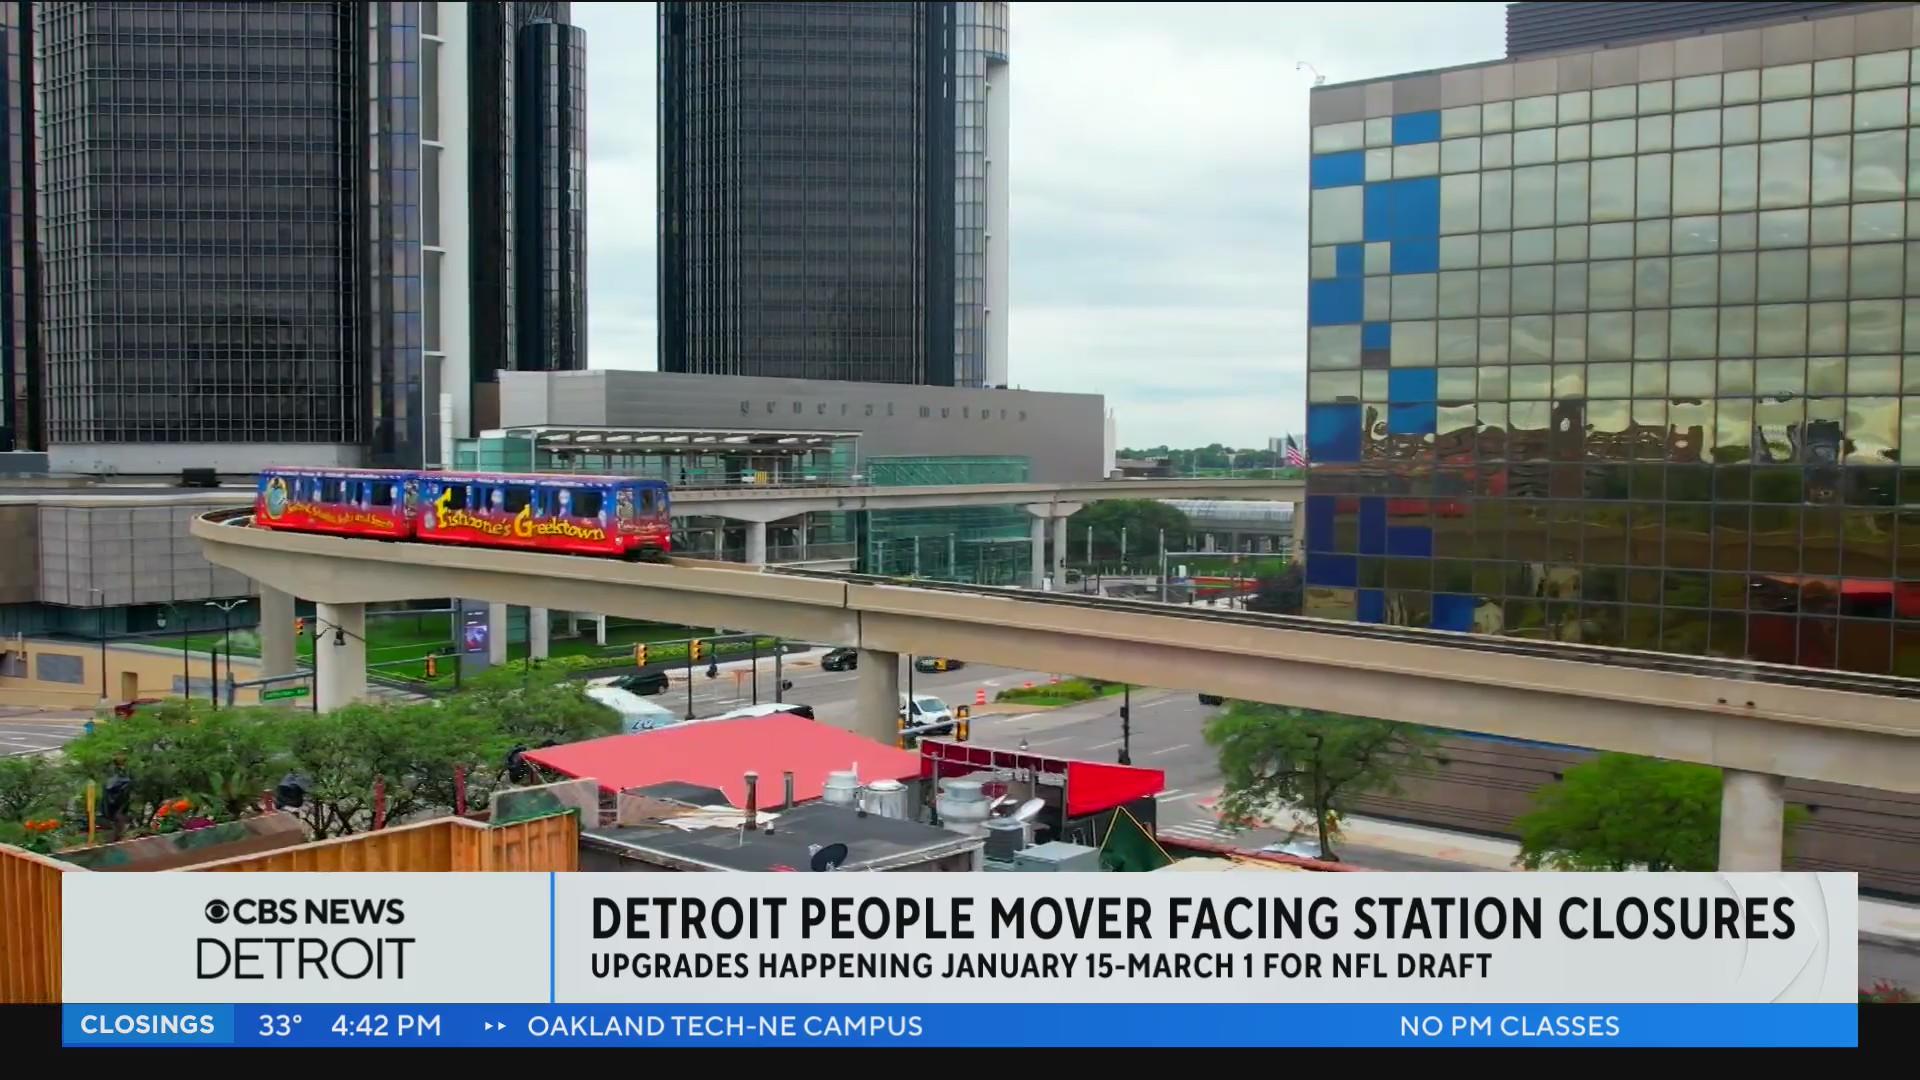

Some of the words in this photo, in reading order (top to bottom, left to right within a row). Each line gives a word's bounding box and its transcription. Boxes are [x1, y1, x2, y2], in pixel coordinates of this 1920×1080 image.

[740, 400, 895, 418] general
[918, 403, 1028, 421] motors
[514, 503, 606, 540] Greektown
